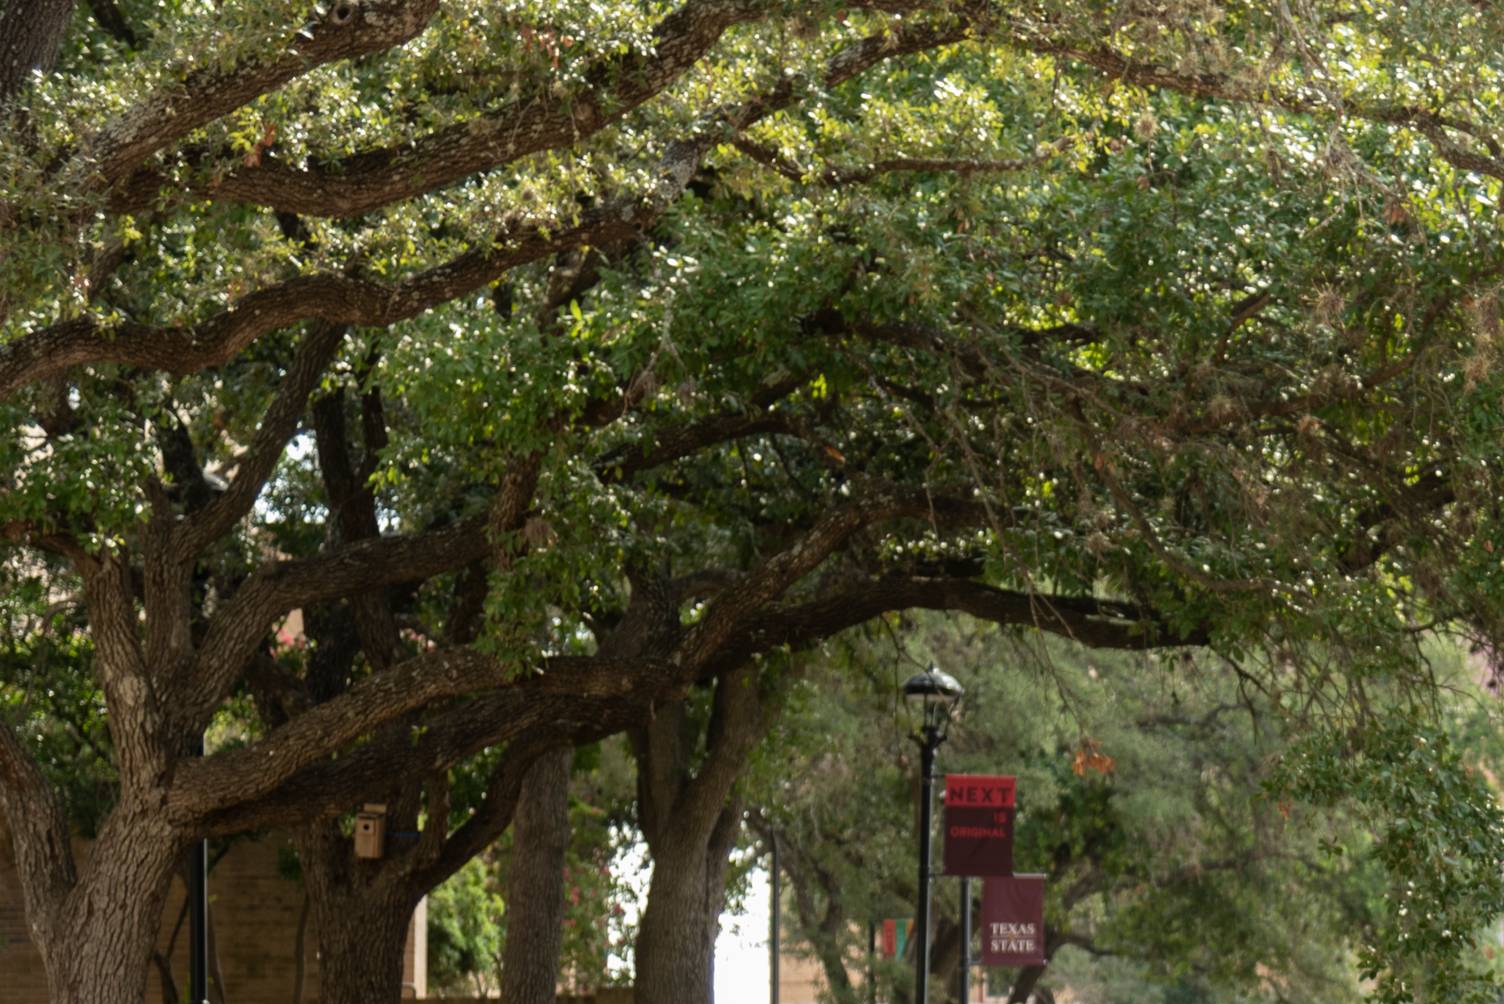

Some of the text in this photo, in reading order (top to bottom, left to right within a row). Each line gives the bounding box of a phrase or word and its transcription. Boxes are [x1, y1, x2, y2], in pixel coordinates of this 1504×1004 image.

[950, 786, 1011, 802] NEXT
[990, 922, 1036, 935] TEXAS
[991, 939, 1036, 953] STATE
